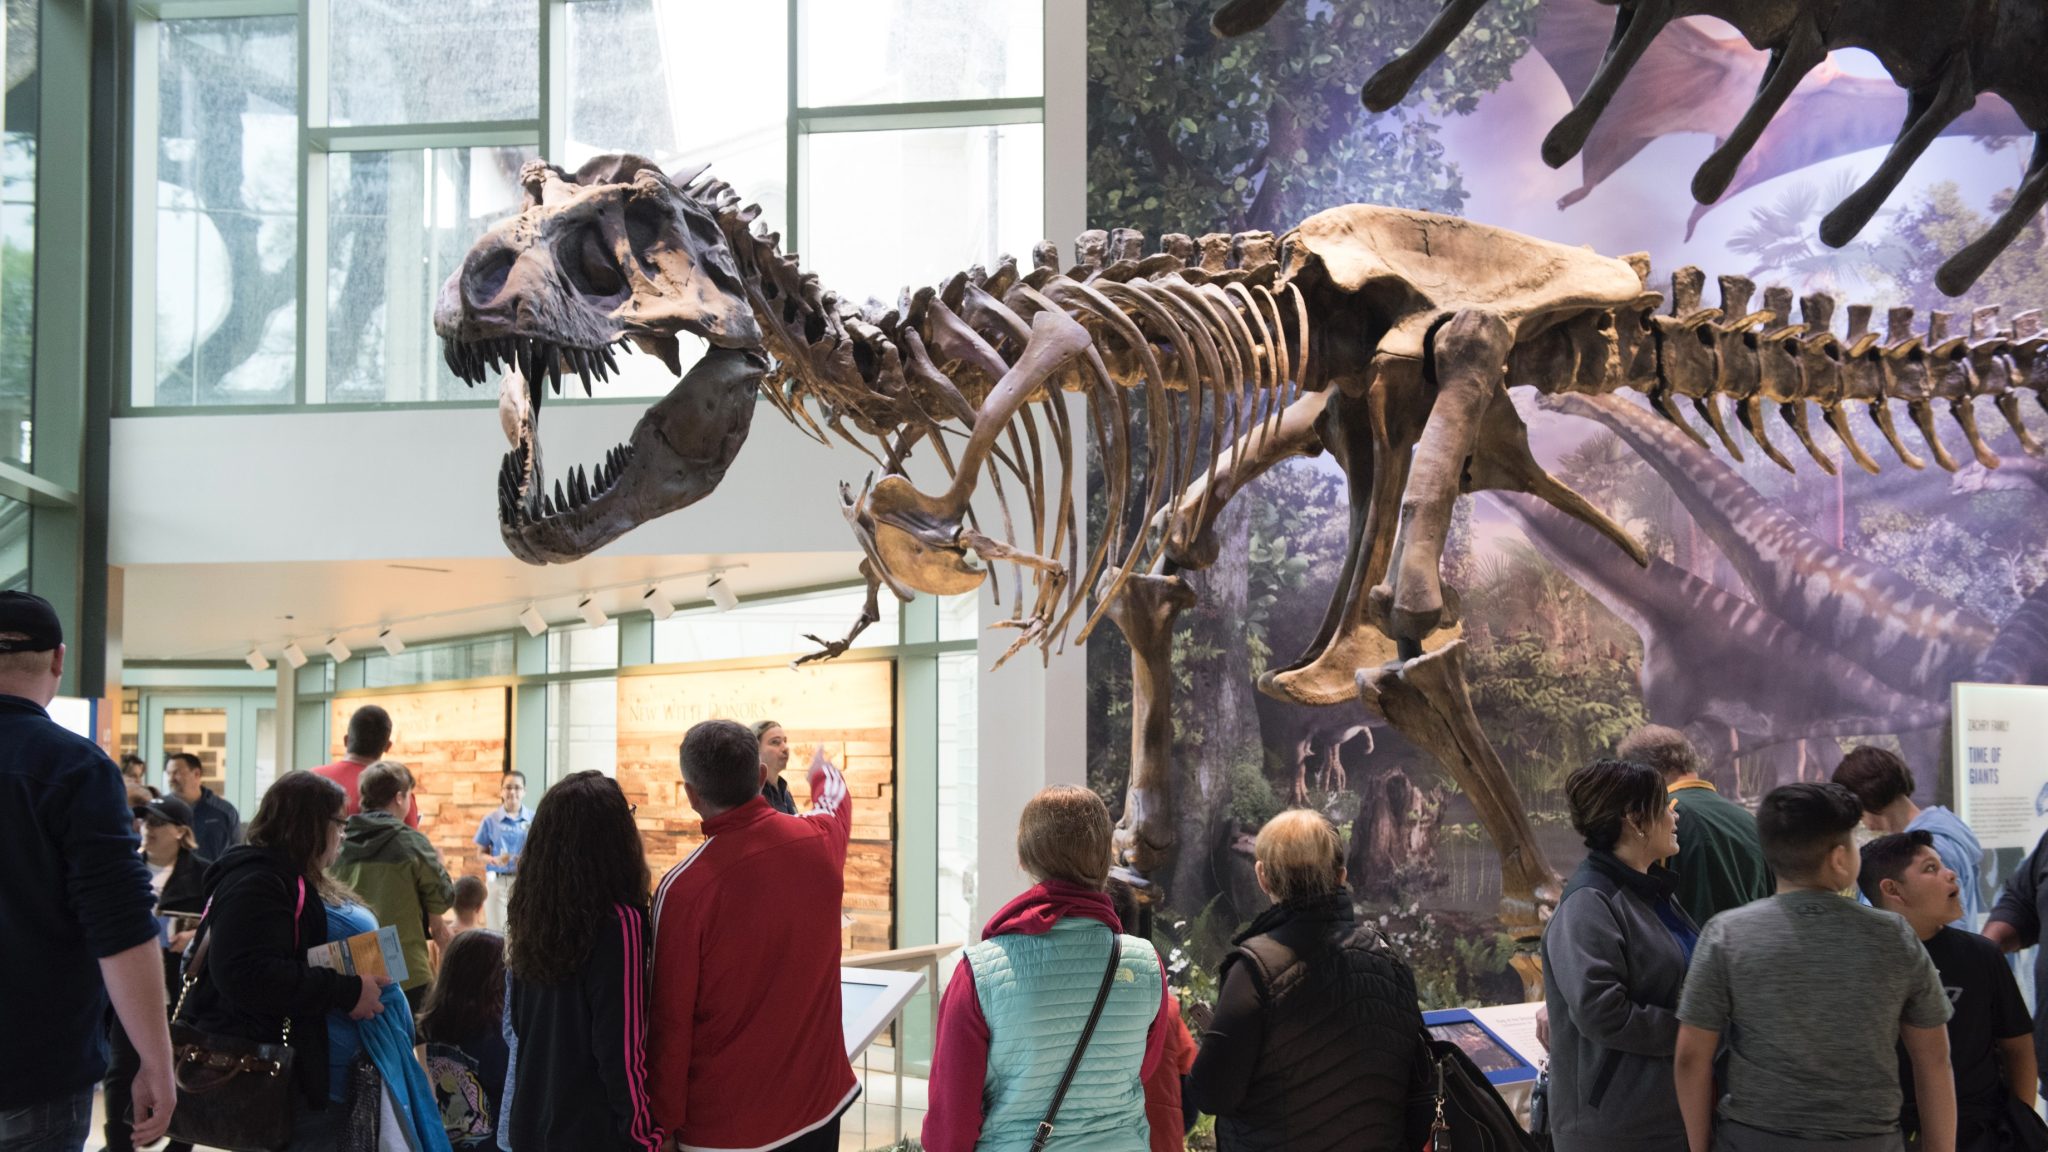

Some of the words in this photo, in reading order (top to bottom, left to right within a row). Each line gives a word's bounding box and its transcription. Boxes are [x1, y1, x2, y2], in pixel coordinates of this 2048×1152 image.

[629, 705, 656, 721] NEW
[709, 702, 767, 719] DONORS
[1967, 719, 1989, 731] ZACHRY
[1991, 720, 2010, 732] FAMILY
[1968, 746, 1988, 763] TIME
[1991, 747, 2002, 763] OF
[1969, 768, 1999, 784] GIANTS
